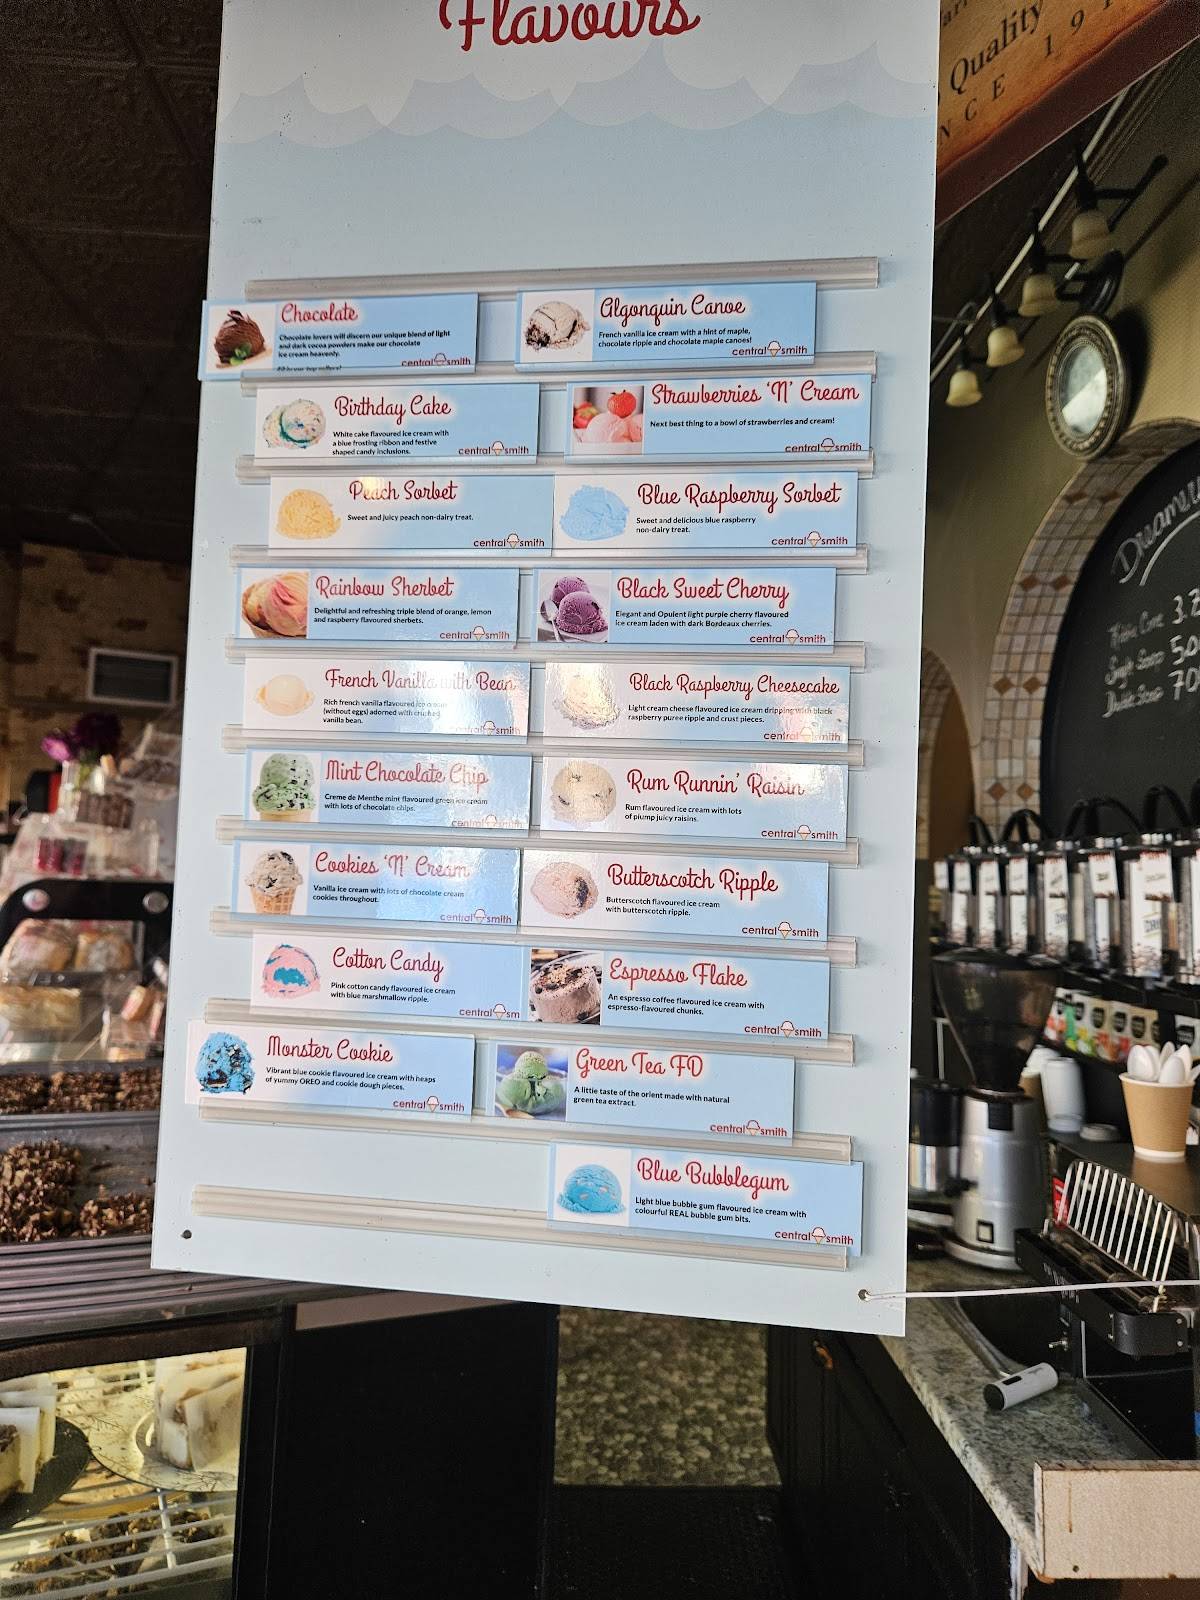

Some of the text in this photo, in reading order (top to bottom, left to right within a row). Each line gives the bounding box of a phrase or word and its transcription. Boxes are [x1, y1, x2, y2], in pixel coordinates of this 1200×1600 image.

[439, 0, 702, 51] Flavours
[949, 0, 1043, 95] Quality
[281, 302, 359, 324] Chocolate
[600, 294, 745, 327] Algonquin Canoe
[732, 345, 807, 356] central smith
[652, 384, 761, 404] Strawberries
[800, 380, 859, 401] Cream
[334, 395, 451, 424] Birthday Cake
[685, 419, 703, 427] thing
[459, 445, 529, 455] central smith
[349, 479, 458, 501] Peach Sorbet
[638, 482, 841, 513] Blue Raspberry Sorbet
[721, 516, 756, 524] raspberry
[474, 538, 544, 548] central smith
[316, 576, 454, 598] Rainbow Sherbet
[617, 577, 789, 608] Black Sweet Cherry
[361, 607, 395, 615] refreshing
[615, 610, 640, 618] Elegant
[657, 610, 686, 618] Opulent
[687, 610, 703, 618] light
[705, 610, 727, 618] purple
[729, 610, 752, 618] cherry
[440, 631, 510, 640] central smith
[750, 634, 825, 643] central smith
[325, 668, 378, 688] French
[476, 671, 518, 691] Bean
[630, 673, 839, 700] Black Raspberry Cheesecake
[628, 714, 661, 722] raspberry
[684, 714, 704, 722] ripple
[739, 715, 765, 723] pieces.
[326, 760, 488, 793] Mint Chocolate Chip
[627, 769, 669, 793] Rum
[747, 773, 805, 797] Raisin
[761, 829, 838, 840] central smith
[316, 852, 379, 874] Cookies
[416, 856, 470, 878] Cream
[608, 864, 778, 901] Butterscotch Ripple
[622, 906, 666, 914] butterscotch
[668, 908, 691, 916] ripple.
[742, 925, 819, 938] central smith
[332, 947, 444, 983] Cotton Candy
[610, 958, 747, 990] Espresso Flake
[346, 982, 368, 990] cotton
[369, 984, 389, 992] candy
[390, 984, 422, 992] flavoured
[607, 1002, 704, 1014] espresso-flavoured chunks.
[619, 995, 650, 1003] espresso
[652, 995, 674, 1003] coffee
[676, 997, 710, 1005] flavoured
[744, 1024, 821, 1038] central smith
[267, 1036, 393, 1062] Monster Cookie
[576, 1048, 704, 1078] Green Tea FD
[393, 1100, 464, 1113] central smith
[595, 1096, 606, 1104] tea
[607, 1097, 636, 1106] extract.
[710, 1123, 787, 1137] central smith
[637, 1158, 789, 1200] Blue Bubblegum
[634, 1206, 751, 1222] colourful REAL bubble gum bits.
